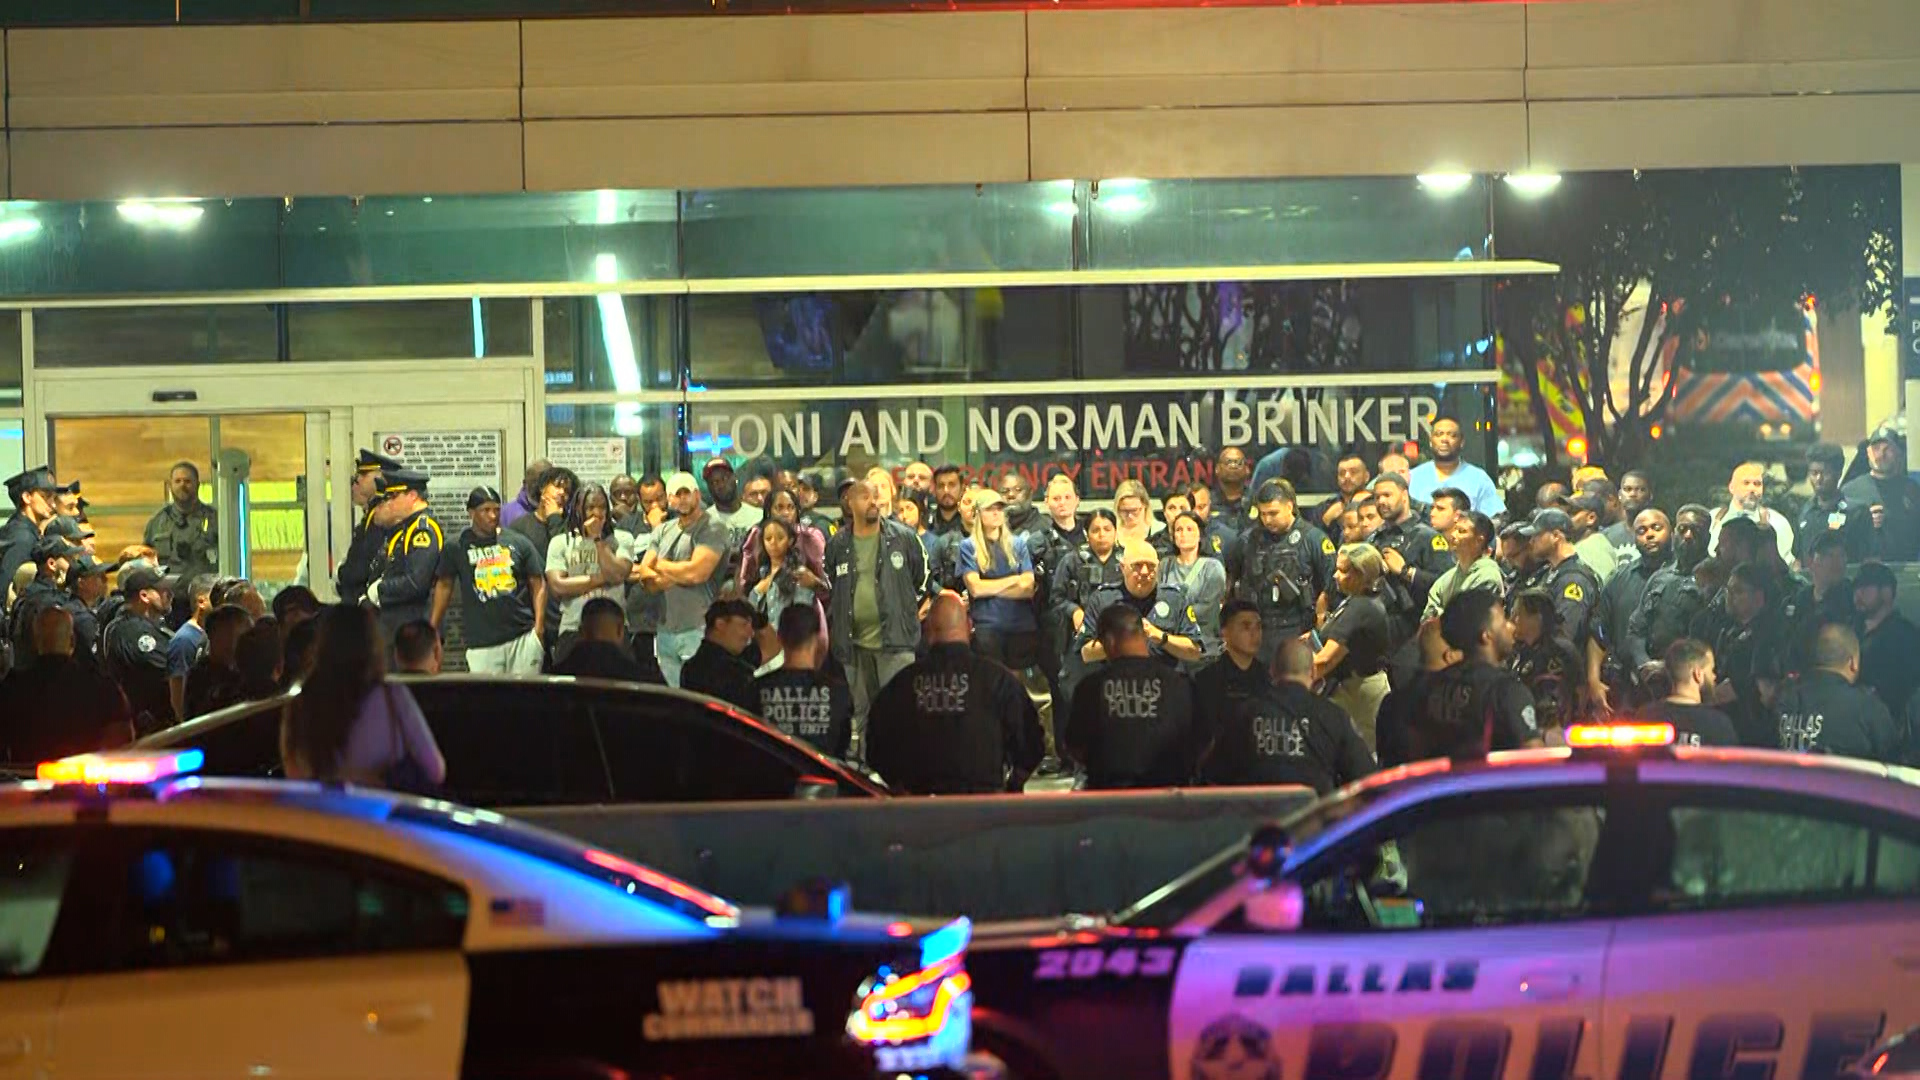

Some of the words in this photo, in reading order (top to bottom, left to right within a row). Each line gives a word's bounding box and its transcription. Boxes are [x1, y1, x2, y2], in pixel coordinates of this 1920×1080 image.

[700, 412, 821, 460] TONI
[839, 408, 948, 457] AND
[968, 401, 1202, 452] NORMAN
[1221, 396, 1437, 446] BRINKER
[1091, 457, 1253, 489] ENTRAN
[760, 685, 831, 702] DALLAS
[914, 673, 969, 696] DALLAS
[1104, 678, 1161, 702] DALLAS
[762, 704, 831, 722] POLICE
[918, 692, 965, 712] POLICE
[1108, 698, 1158, 718] POLICE
[1252, 715, 1310, 742] DALLAS
[1779, 713, 1824, 738] DALLAS
[1257, 734, 1305, 756] POLICE
[1035, 947, 1176, 978] 2043
[1233, 959, 1479, 996] DALLAS
[657, 976, 803, 1016] WATCH
